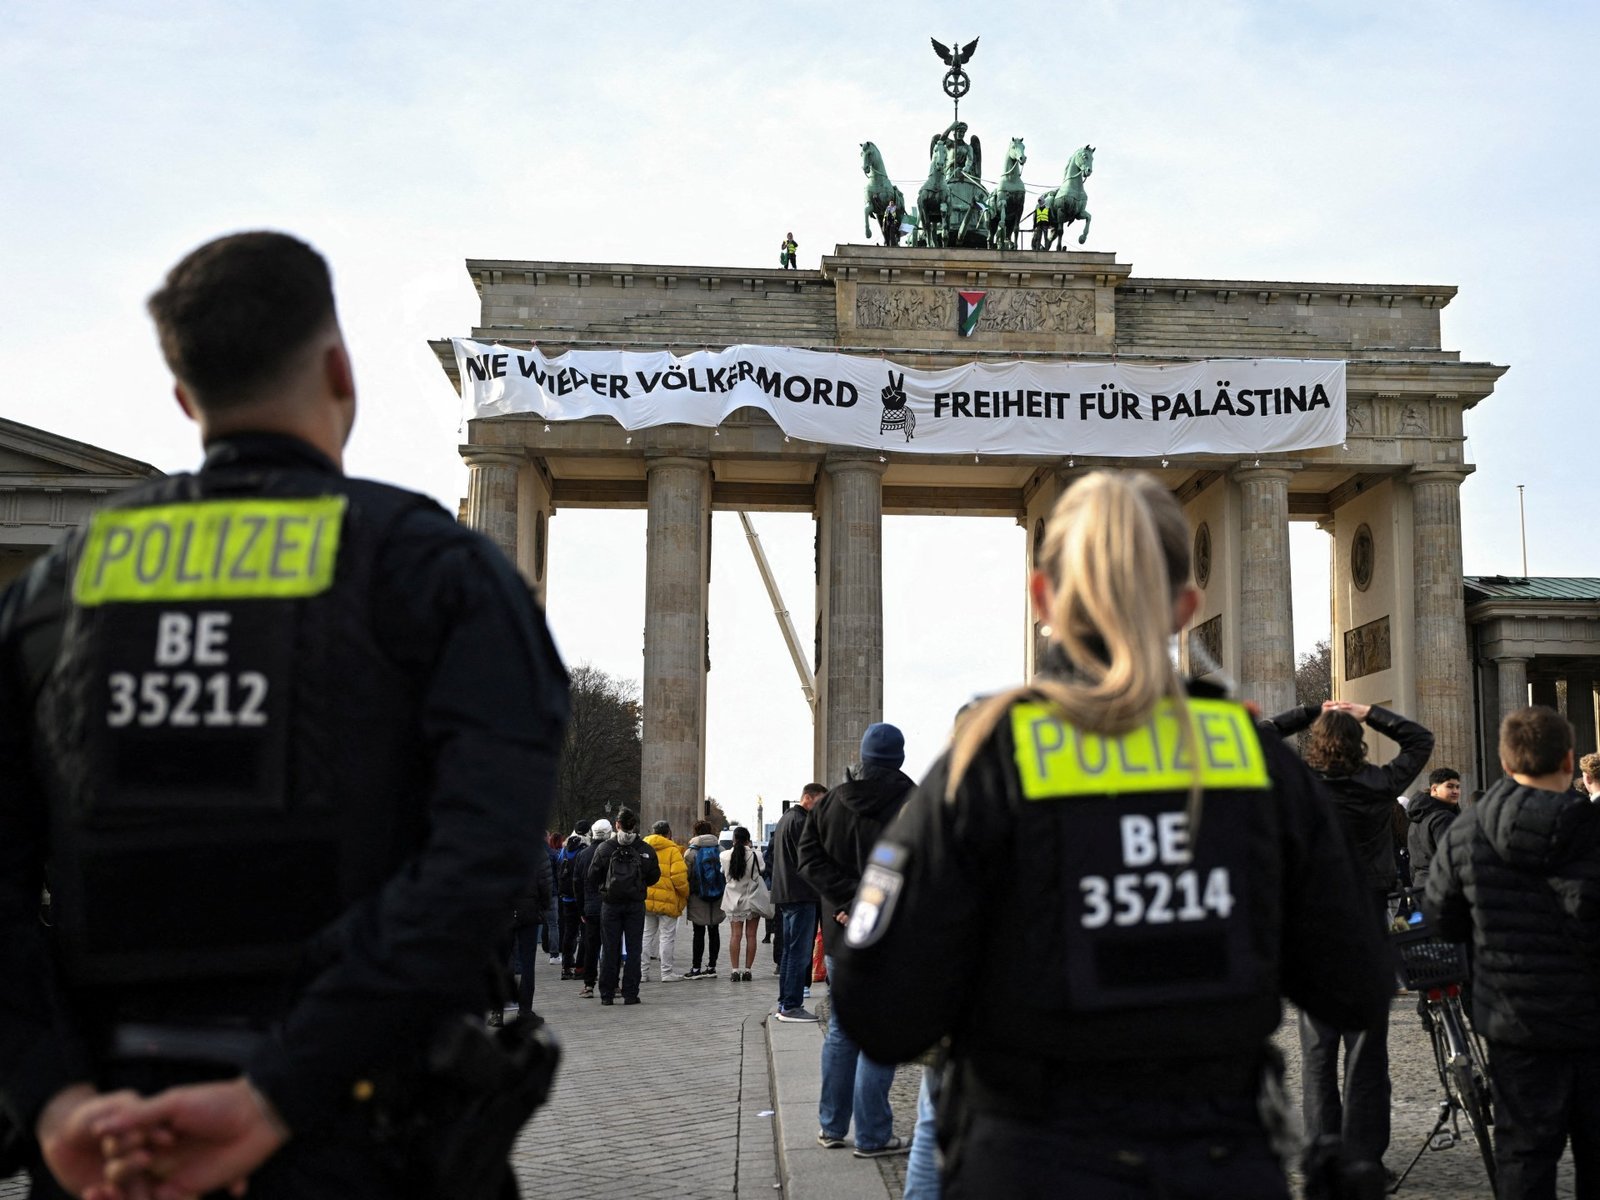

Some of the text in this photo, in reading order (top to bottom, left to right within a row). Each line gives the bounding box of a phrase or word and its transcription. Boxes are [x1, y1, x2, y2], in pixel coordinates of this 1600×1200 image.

[466, 353, 859, 407] NIE WIEDER VÖLKERMORD
[934, 380, 1331, 421] FREIHEIT FÜR PALÄSTINA
[92, 515, 326, 588] POLIZEI
[155, 612, 232, 665] BE
[107, 672, 268, 726] 35212
[1120, 812, 1192, 867] BE
[1079, 867, 1235, 928] 35214
